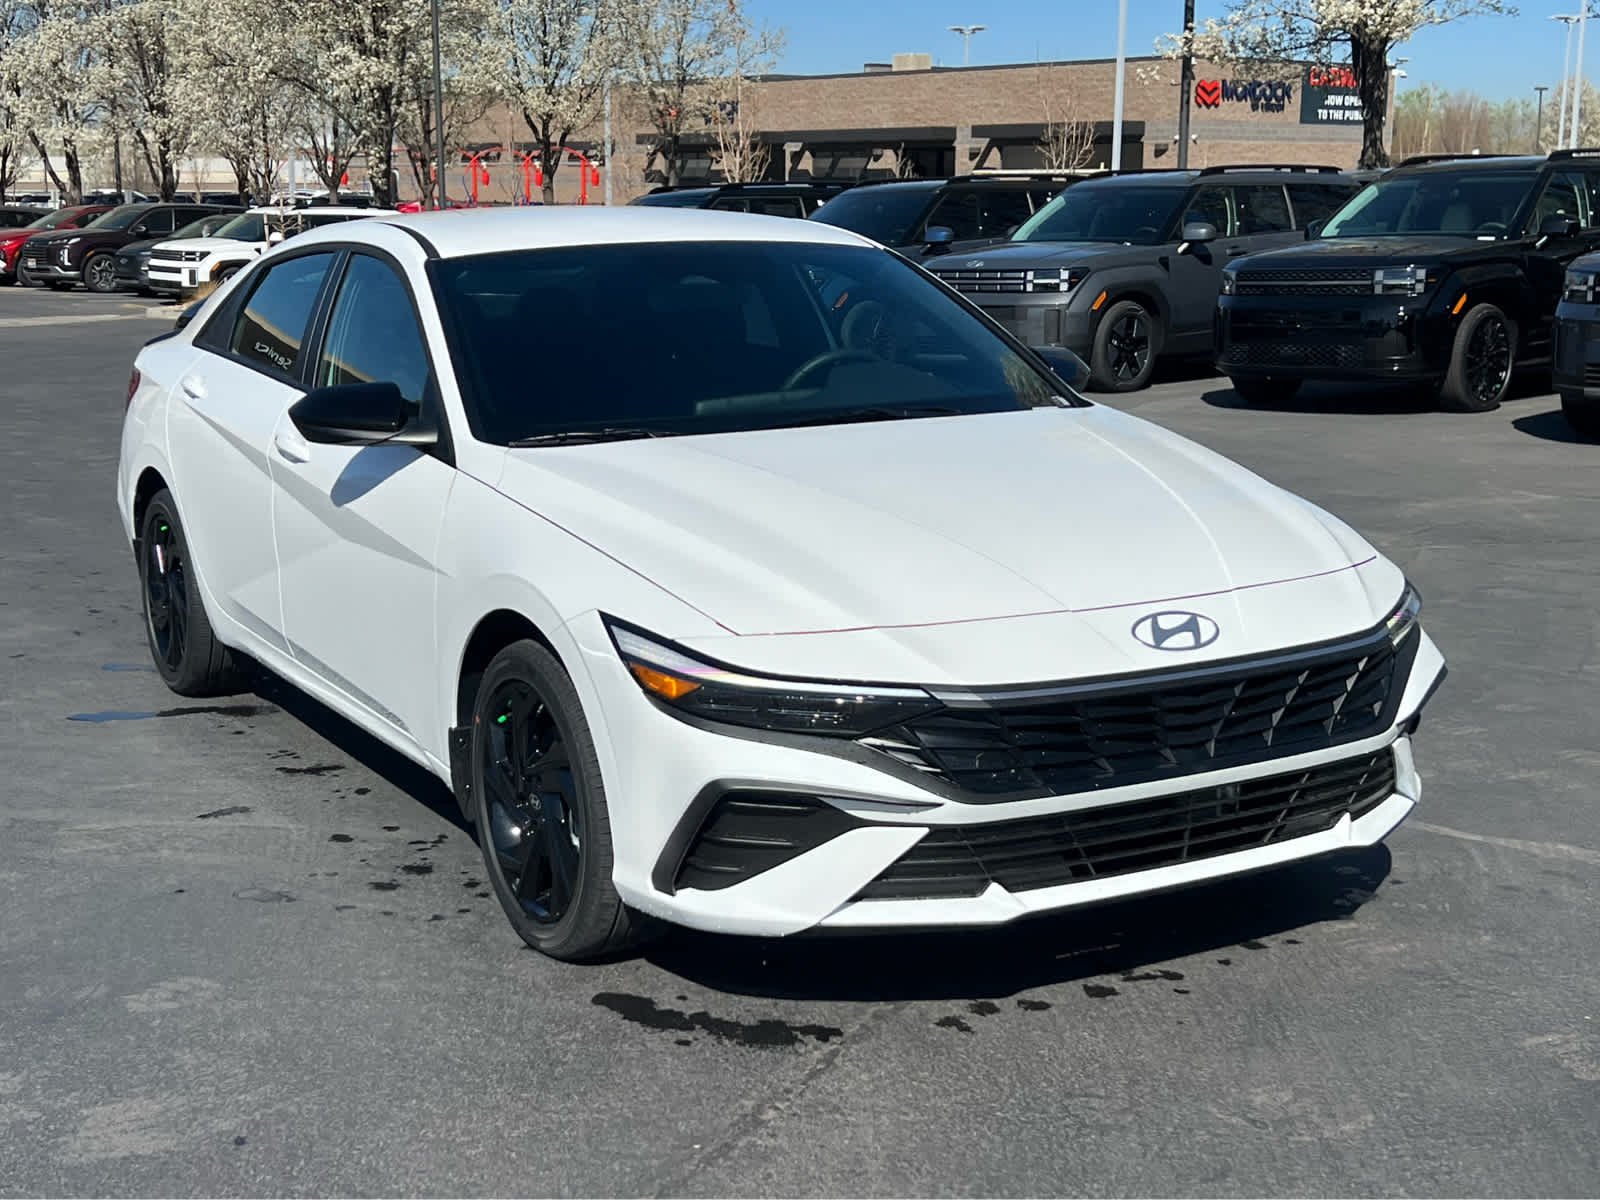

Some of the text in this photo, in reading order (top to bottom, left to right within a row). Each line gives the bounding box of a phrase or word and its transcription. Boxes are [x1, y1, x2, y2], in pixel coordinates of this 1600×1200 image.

[1345, 95, 1363, 107] OPE
[1317, 109, 1328, 120] TO
[1329, 109, 1344, 120] THE
